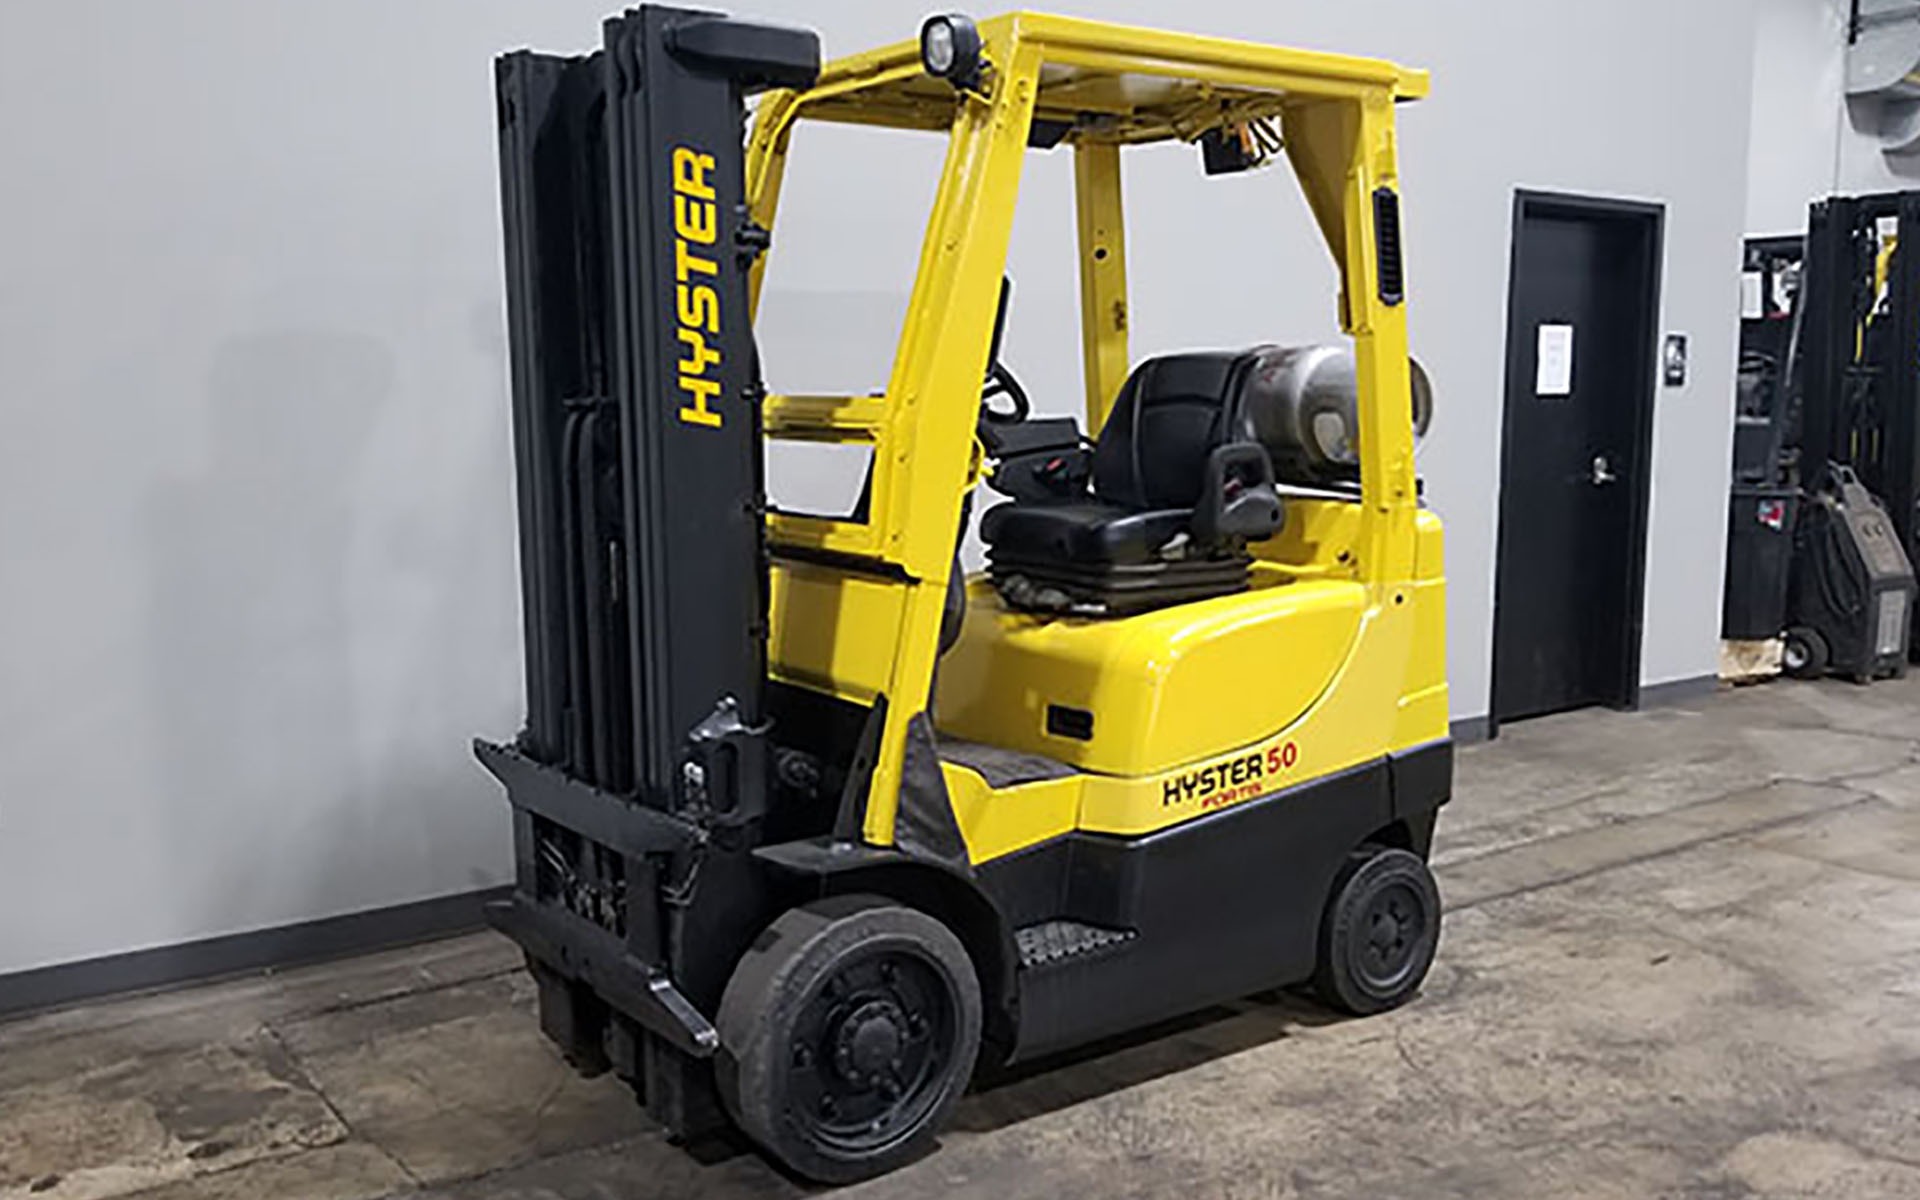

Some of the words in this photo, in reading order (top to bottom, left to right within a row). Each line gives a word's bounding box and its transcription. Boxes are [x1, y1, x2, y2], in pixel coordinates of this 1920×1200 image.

[672, 146, 723, 428] HYSTER
[1163, 753, 1263, 806] HYSTER
[1267, 742, 1297, 774] 50
